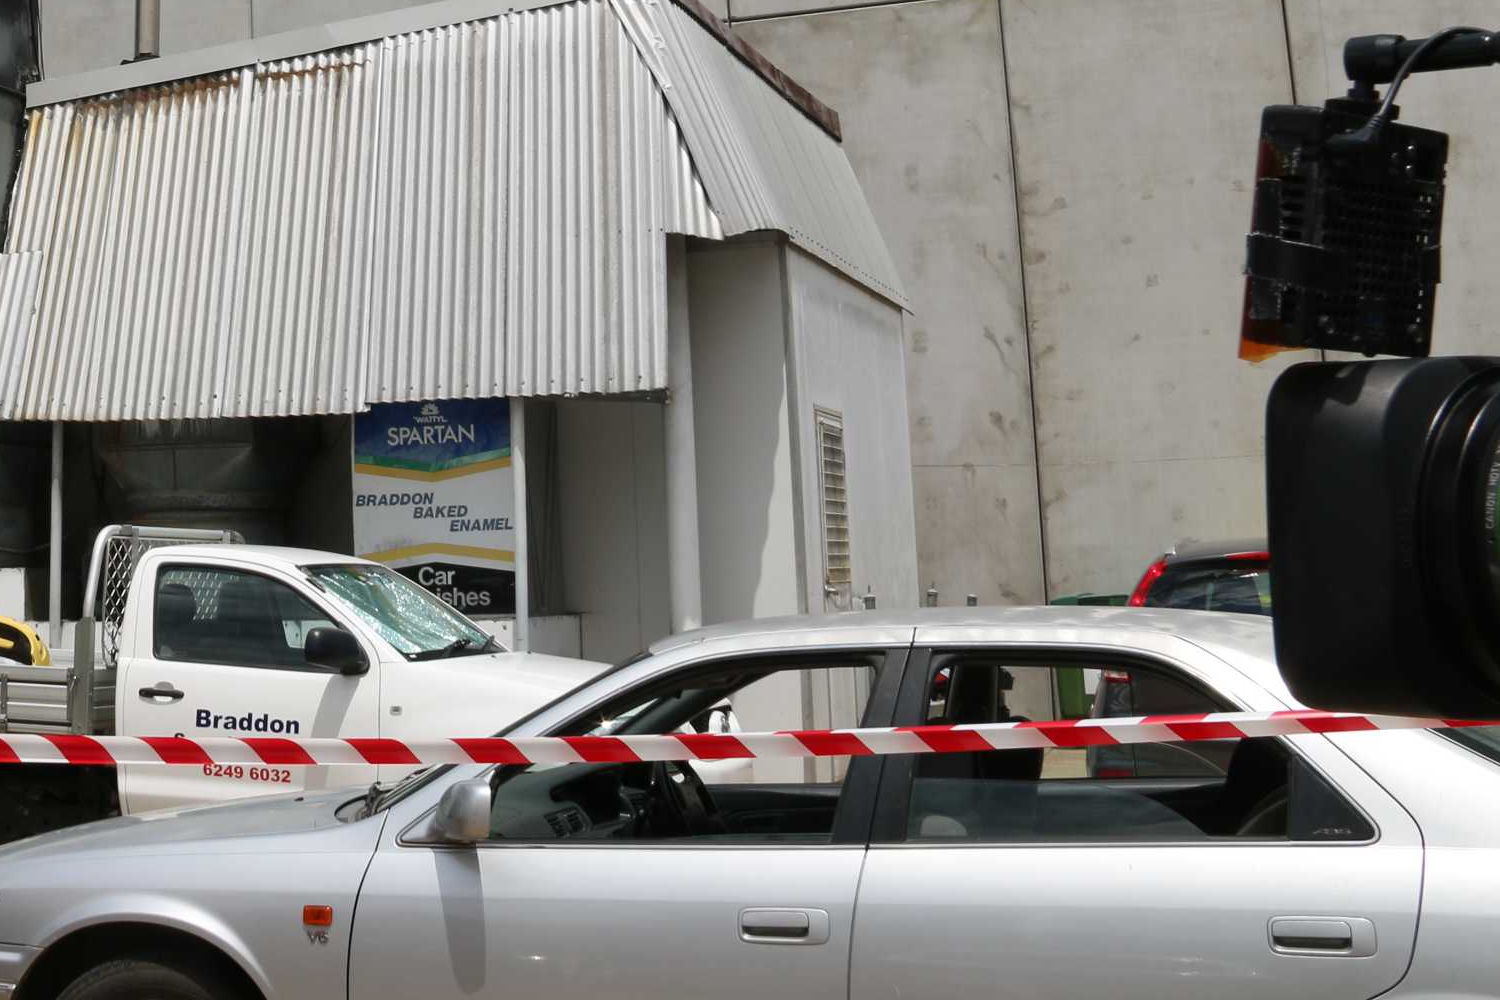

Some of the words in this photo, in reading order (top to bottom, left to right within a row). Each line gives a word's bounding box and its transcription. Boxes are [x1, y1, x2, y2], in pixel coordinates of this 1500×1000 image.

[387, 424, 476, 446] SPARTAN
[355, 492, 435, 507] BRADDON
[413, 504, 468, 519] BAKED
[449, 517, 514, 532] ENAMEL
[418, 566, 456, 586] Car
[436, 586, 492, 607] ishes
[195, 709, 300, 734] Braddon
[203, 763, 244, 779] 6249
[249, 767, 291, 783] 6032
[307, 929, 329, 945] V6
